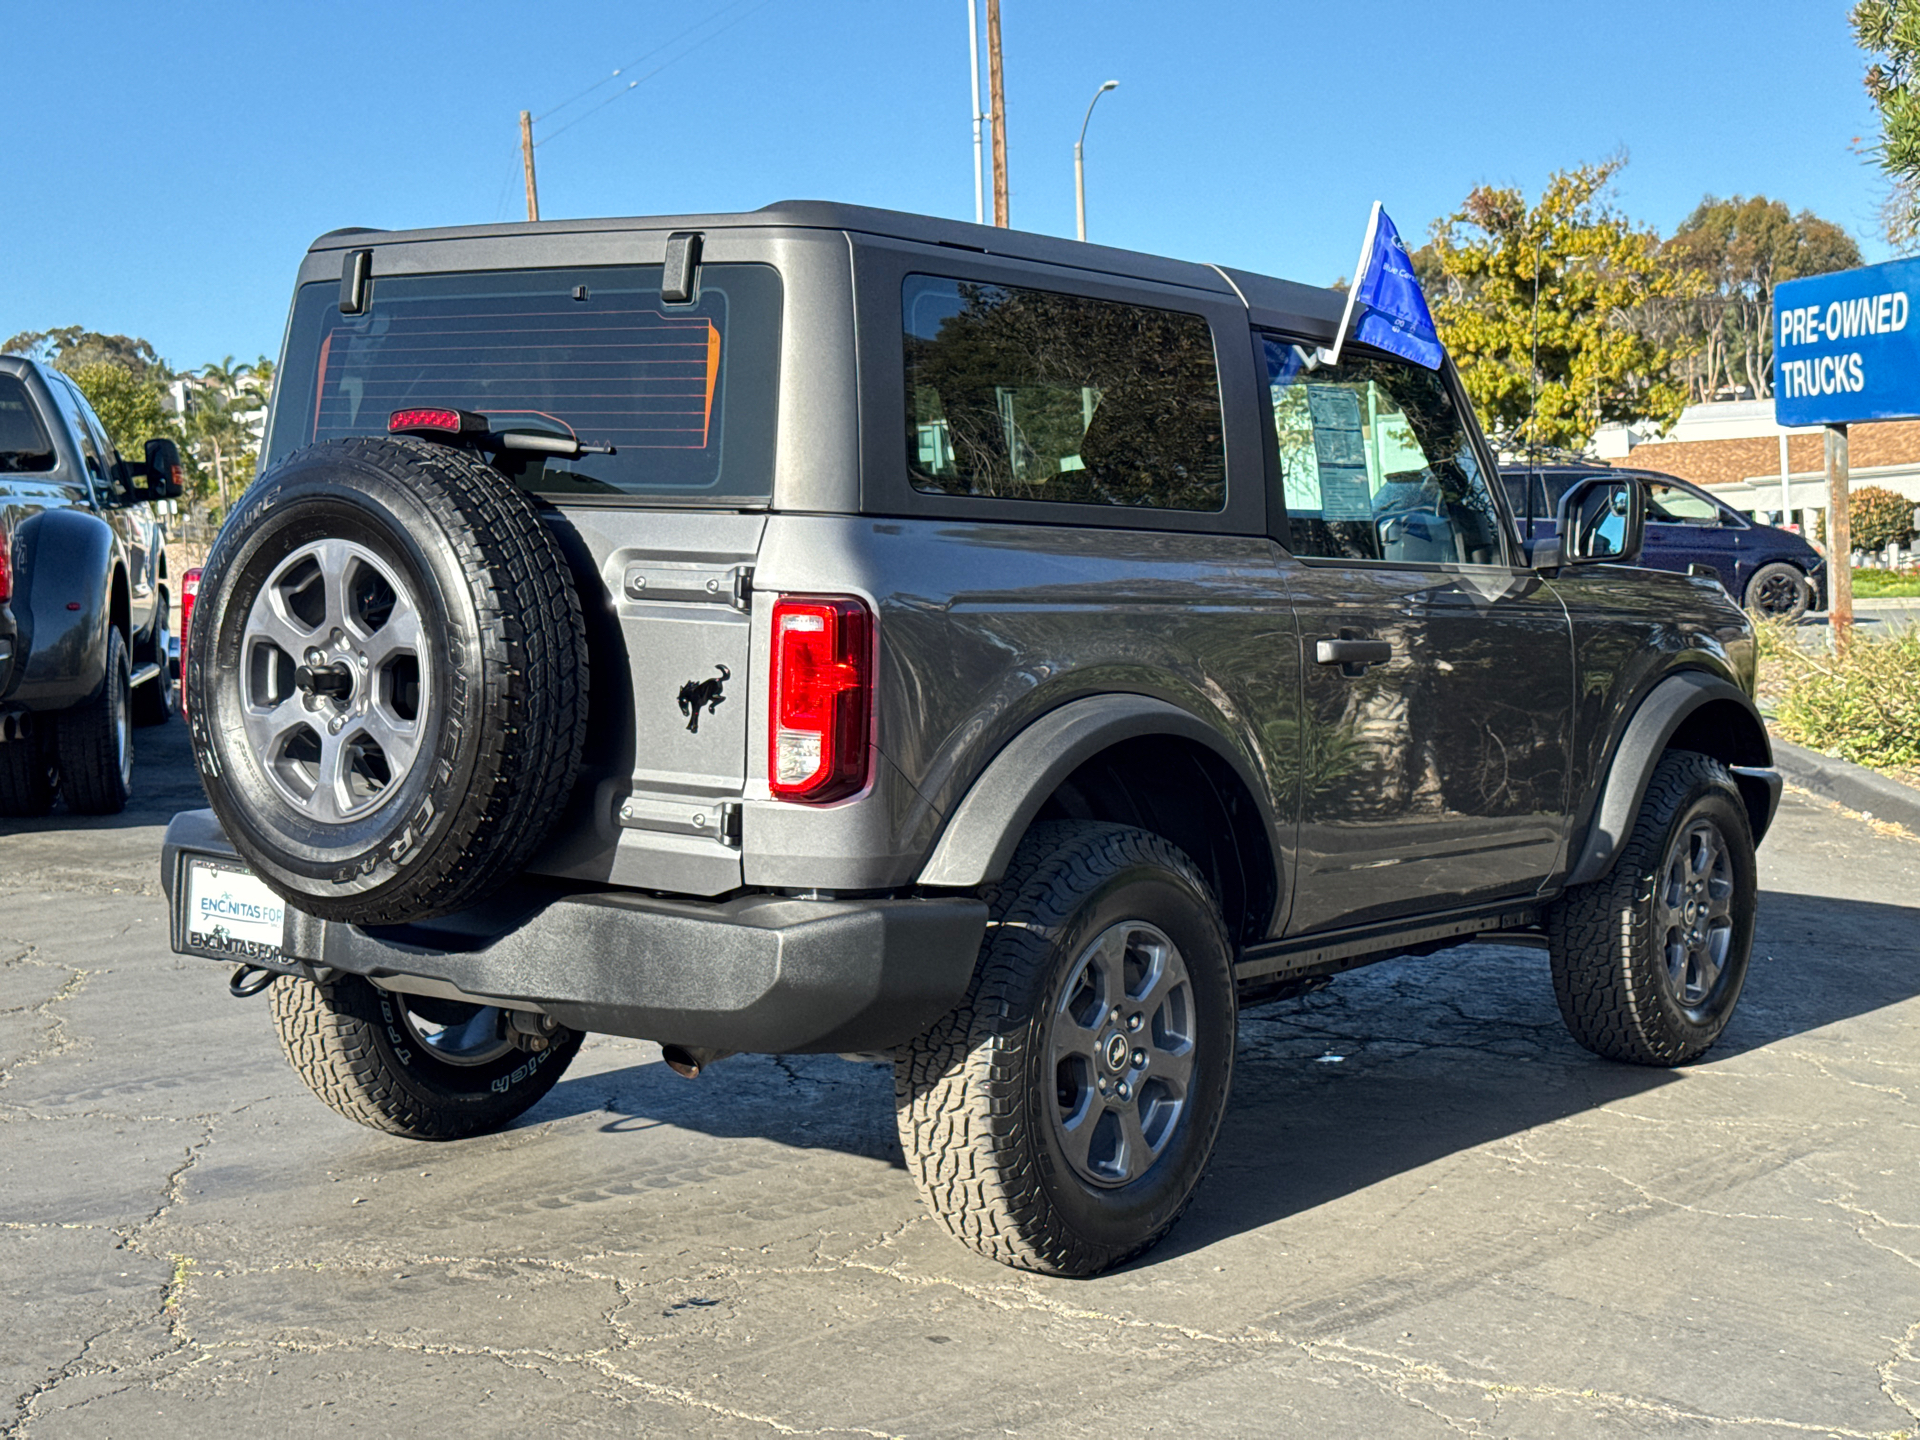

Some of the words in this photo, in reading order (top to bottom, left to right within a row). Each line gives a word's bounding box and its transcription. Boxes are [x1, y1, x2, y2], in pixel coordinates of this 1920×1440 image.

[1781, 291, 1909, 347] PRE-OWNED
[1781, 352, 1865, 398] TRUCKS
[331, 853, 380, 884] A/T
[190, 932, 257, 956] ENCINITAS
